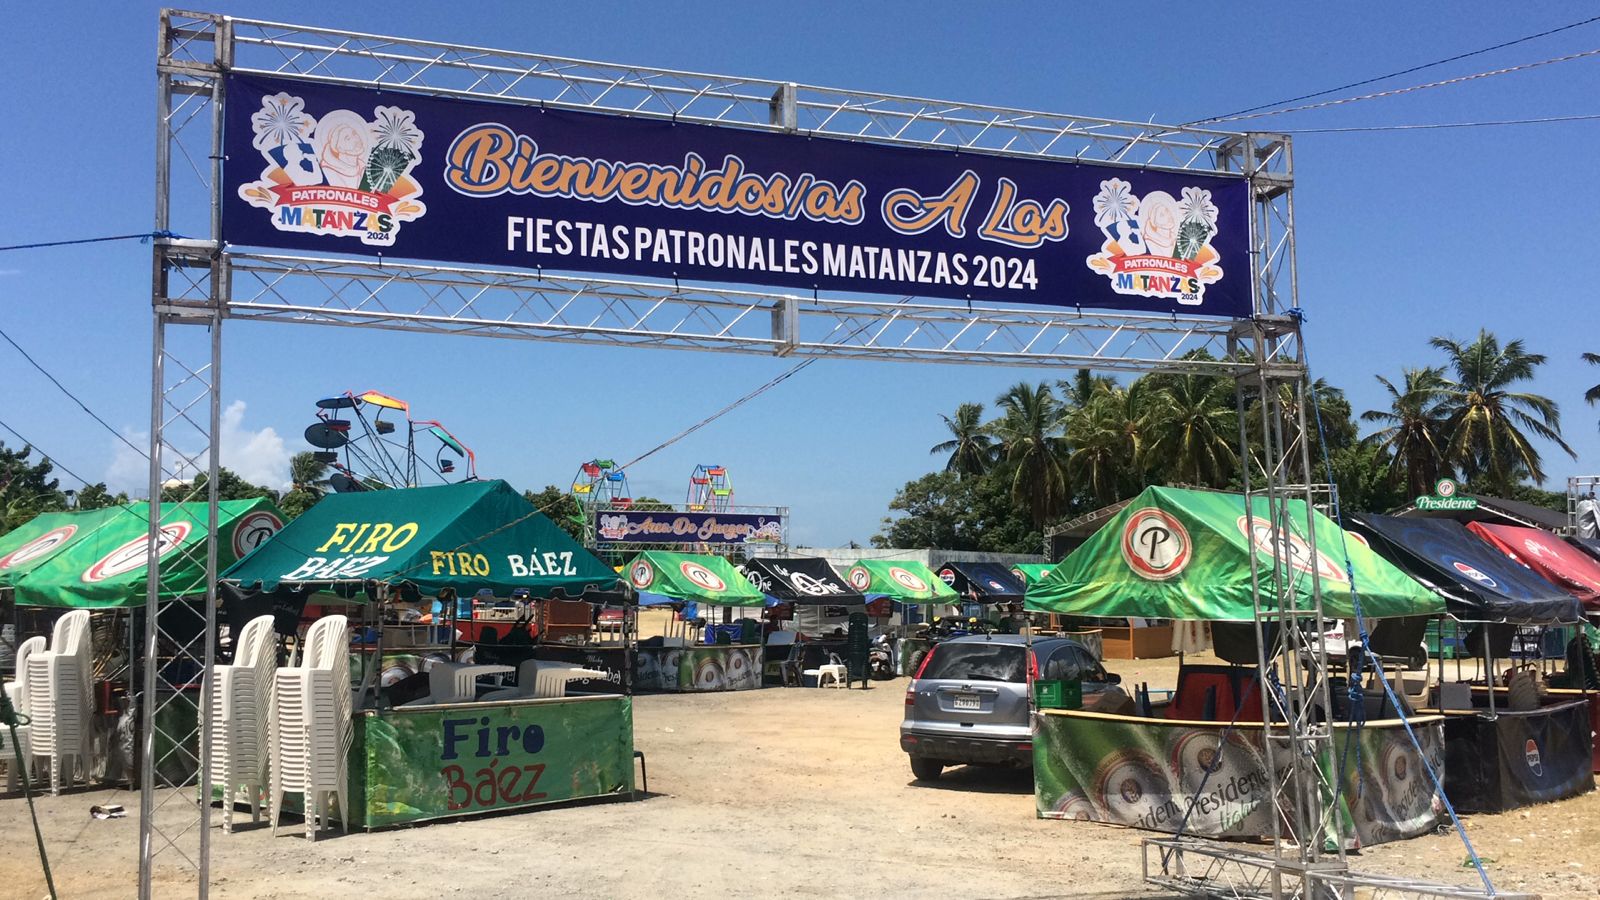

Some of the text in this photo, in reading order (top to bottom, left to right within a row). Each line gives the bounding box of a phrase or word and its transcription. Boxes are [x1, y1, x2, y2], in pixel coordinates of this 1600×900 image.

[291, 190, 379, 207] PATRONALES
[445, 123, 1070, 249] Bienvenidos/as A Las
[280, 206, 393, 233] MATANZAS
[366, 231, 389, 241] 2024
[507, 216, 1039, 291] FIESTAS PATRONALES MATANZAS 2024
[1124, 259, 1188, 273] PATRONALES
[1116, 273, 1200, 294] MATANZAS
[1181, 293, 1198, 301] 2024
[1416, 496, 1477, 510] Presidente
[316, 522, 419, 554] FIRO
[430, 547, 577, 577] FIRO BÁEZ
[441, 717, 545, 760] Firo
[441, 758, 548, 810] Báez
